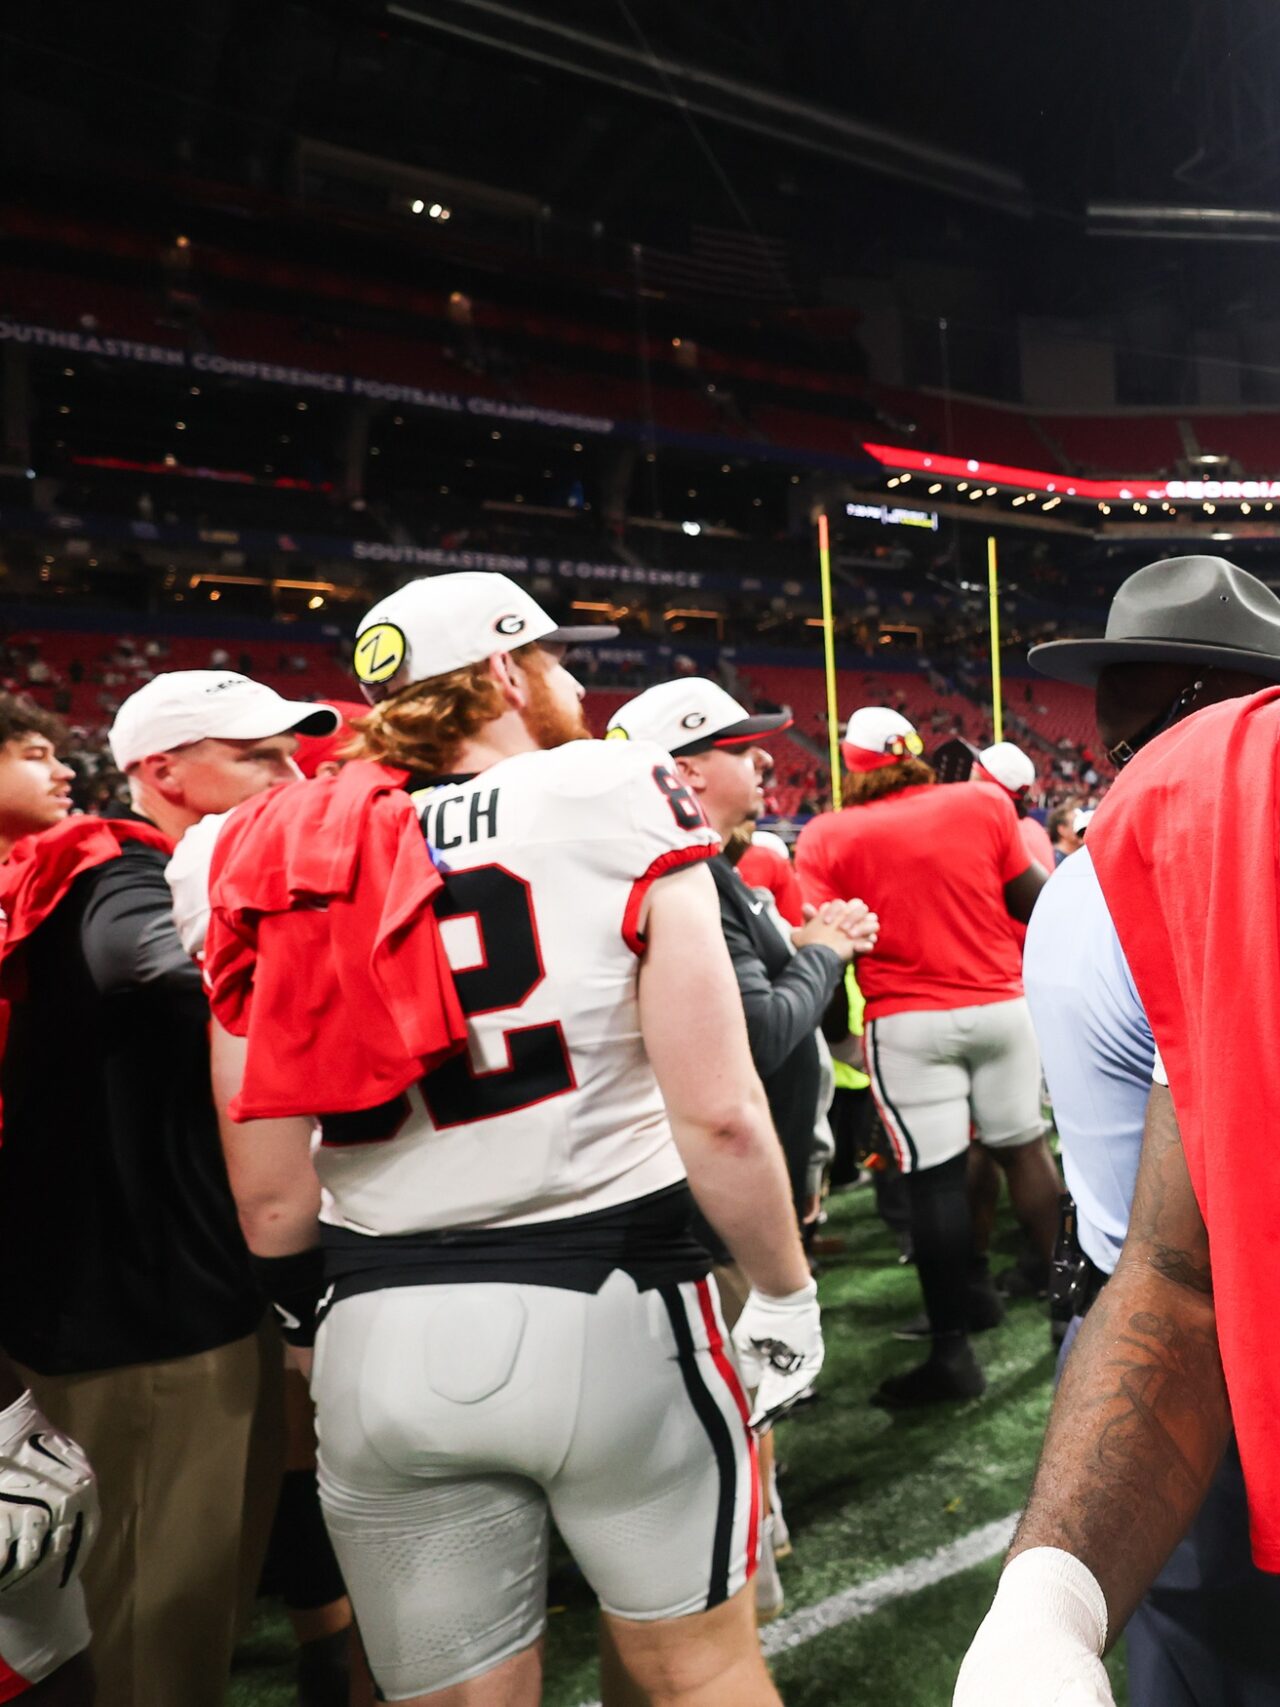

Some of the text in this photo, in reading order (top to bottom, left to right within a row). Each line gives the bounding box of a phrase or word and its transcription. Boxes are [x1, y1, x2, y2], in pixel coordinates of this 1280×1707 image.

[558, 556, 702, 589] CONFERENCE
[494, 614, 526, 635] G
[652, 765, 712, 832] 8
[322, 863, 578, 1147] 2
